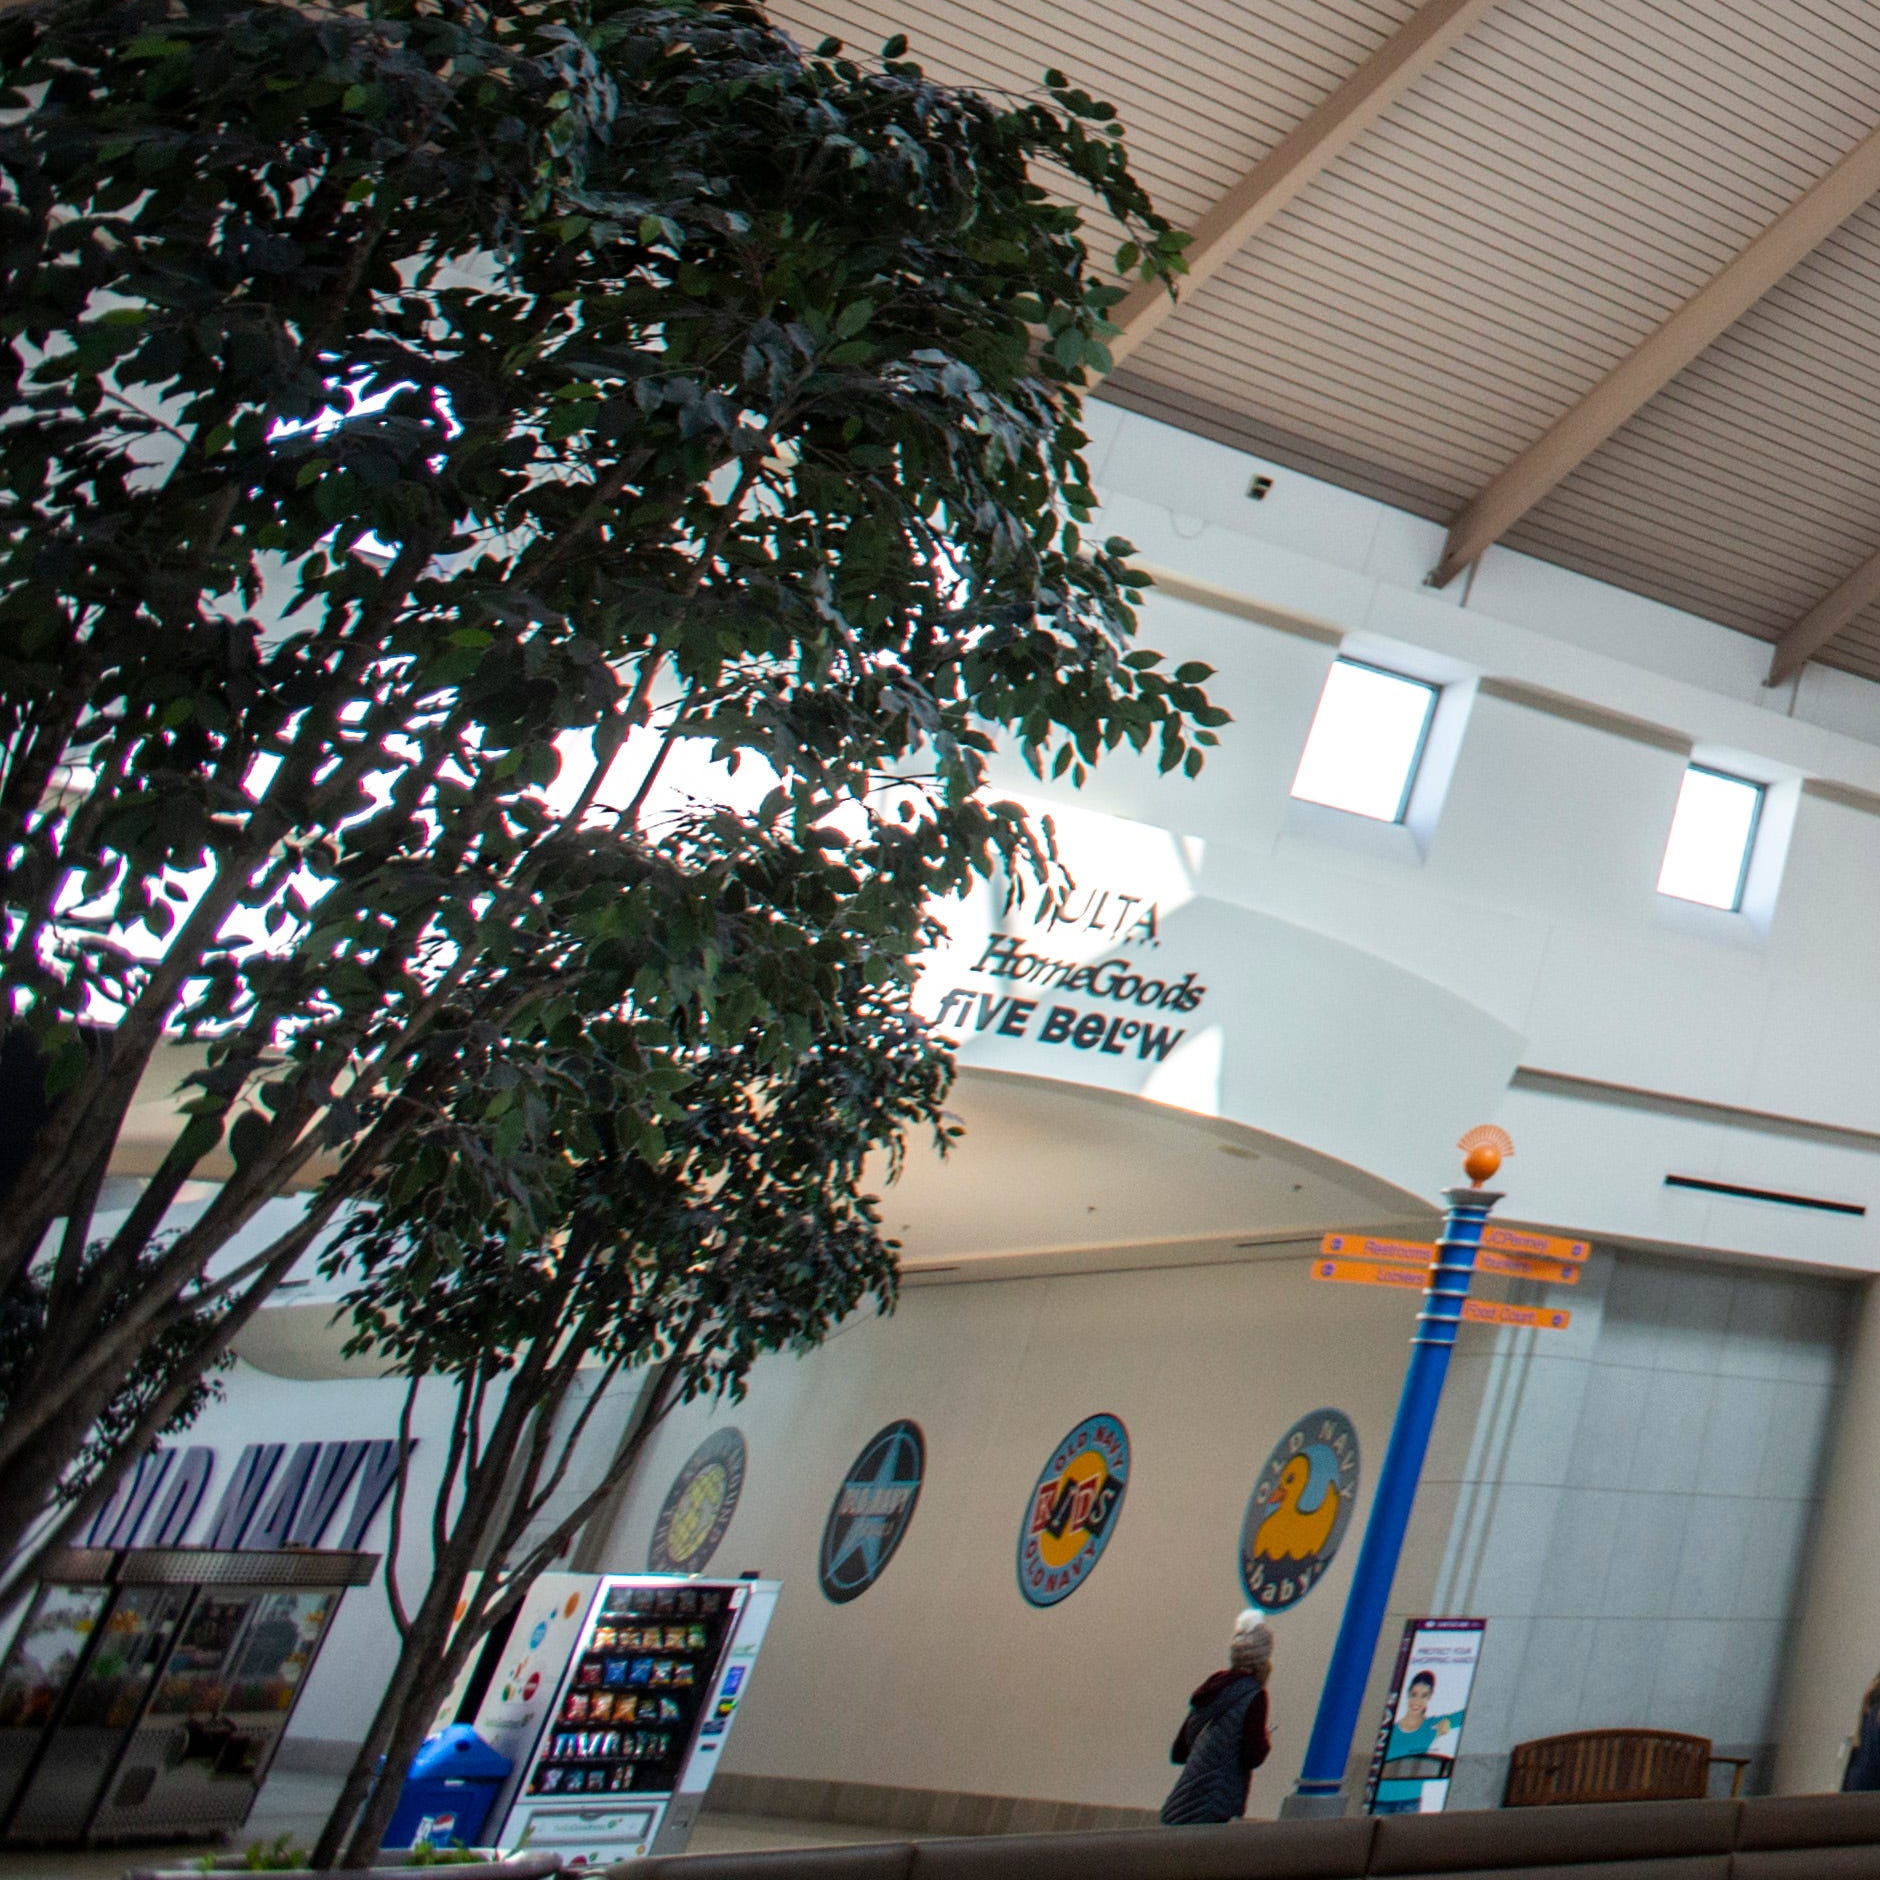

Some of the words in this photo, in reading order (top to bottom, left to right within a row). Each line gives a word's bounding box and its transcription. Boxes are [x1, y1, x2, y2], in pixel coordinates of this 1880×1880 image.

[1058, 888, 1159, 941] ULTA
[970, 933, 1206, 1012] HomeGoods
[1467, 1303, 1496, 1319] Food
[1055, 1432, 1088, 1471] OLD
[1093, 1426, 1123, 1467] NAVY
[1257, 1431, 1305, 1505] OLD
[1318, 1420, 1355, 1498] NAVY
[203, 1438, 419, 1552] NAVY
[1250, 1563, 1312, 1603] baby
